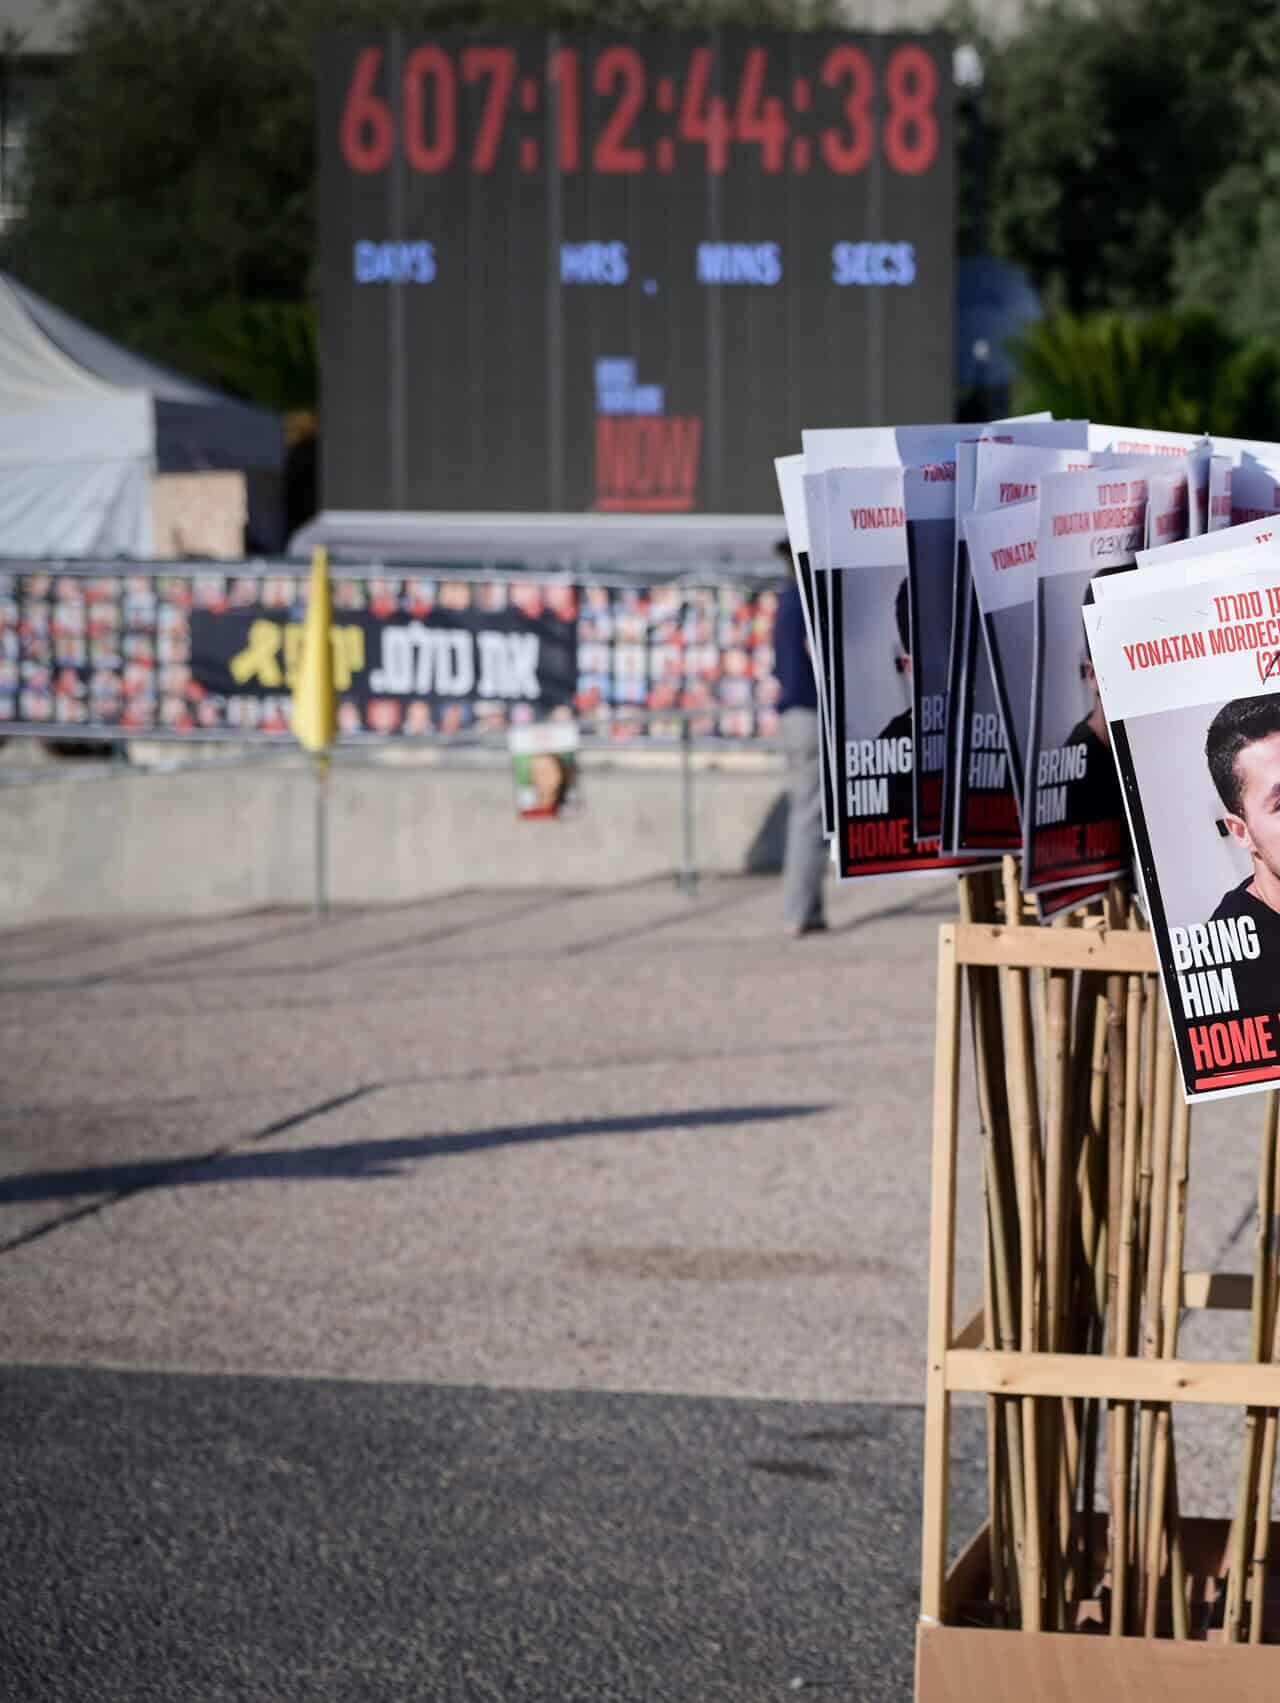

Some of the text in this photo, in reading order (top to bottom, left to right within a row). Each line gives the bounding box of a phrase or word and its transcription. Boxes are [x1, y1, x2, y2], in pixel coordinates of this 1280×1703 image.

[341, 47, 939, 174] 607:12:44:38
[354, 241, 916, 286] DAYS HRS MINS SECS
[1214, 594, 1263, 624] סמרנו
[369, 620, 476, 695] כולם.
[476, 630, 541, 700] את
[1123, 631, 1207, 672] YONATAN
[846, 736, 914, 778] BRING
[969, 752, 1008, 790] HIM
[1037, 743, 1088, 785] BRING
[847, 778, 889, 817] HIM
[1036, 785, 1067, 827] HIM
[847, 818, 911, 859] HOME
[1168, 914, 1262, 971] BRING
[1178, 966, 1240, 1020] HIM
[1188, 1014, 1278, 1072] HOME
